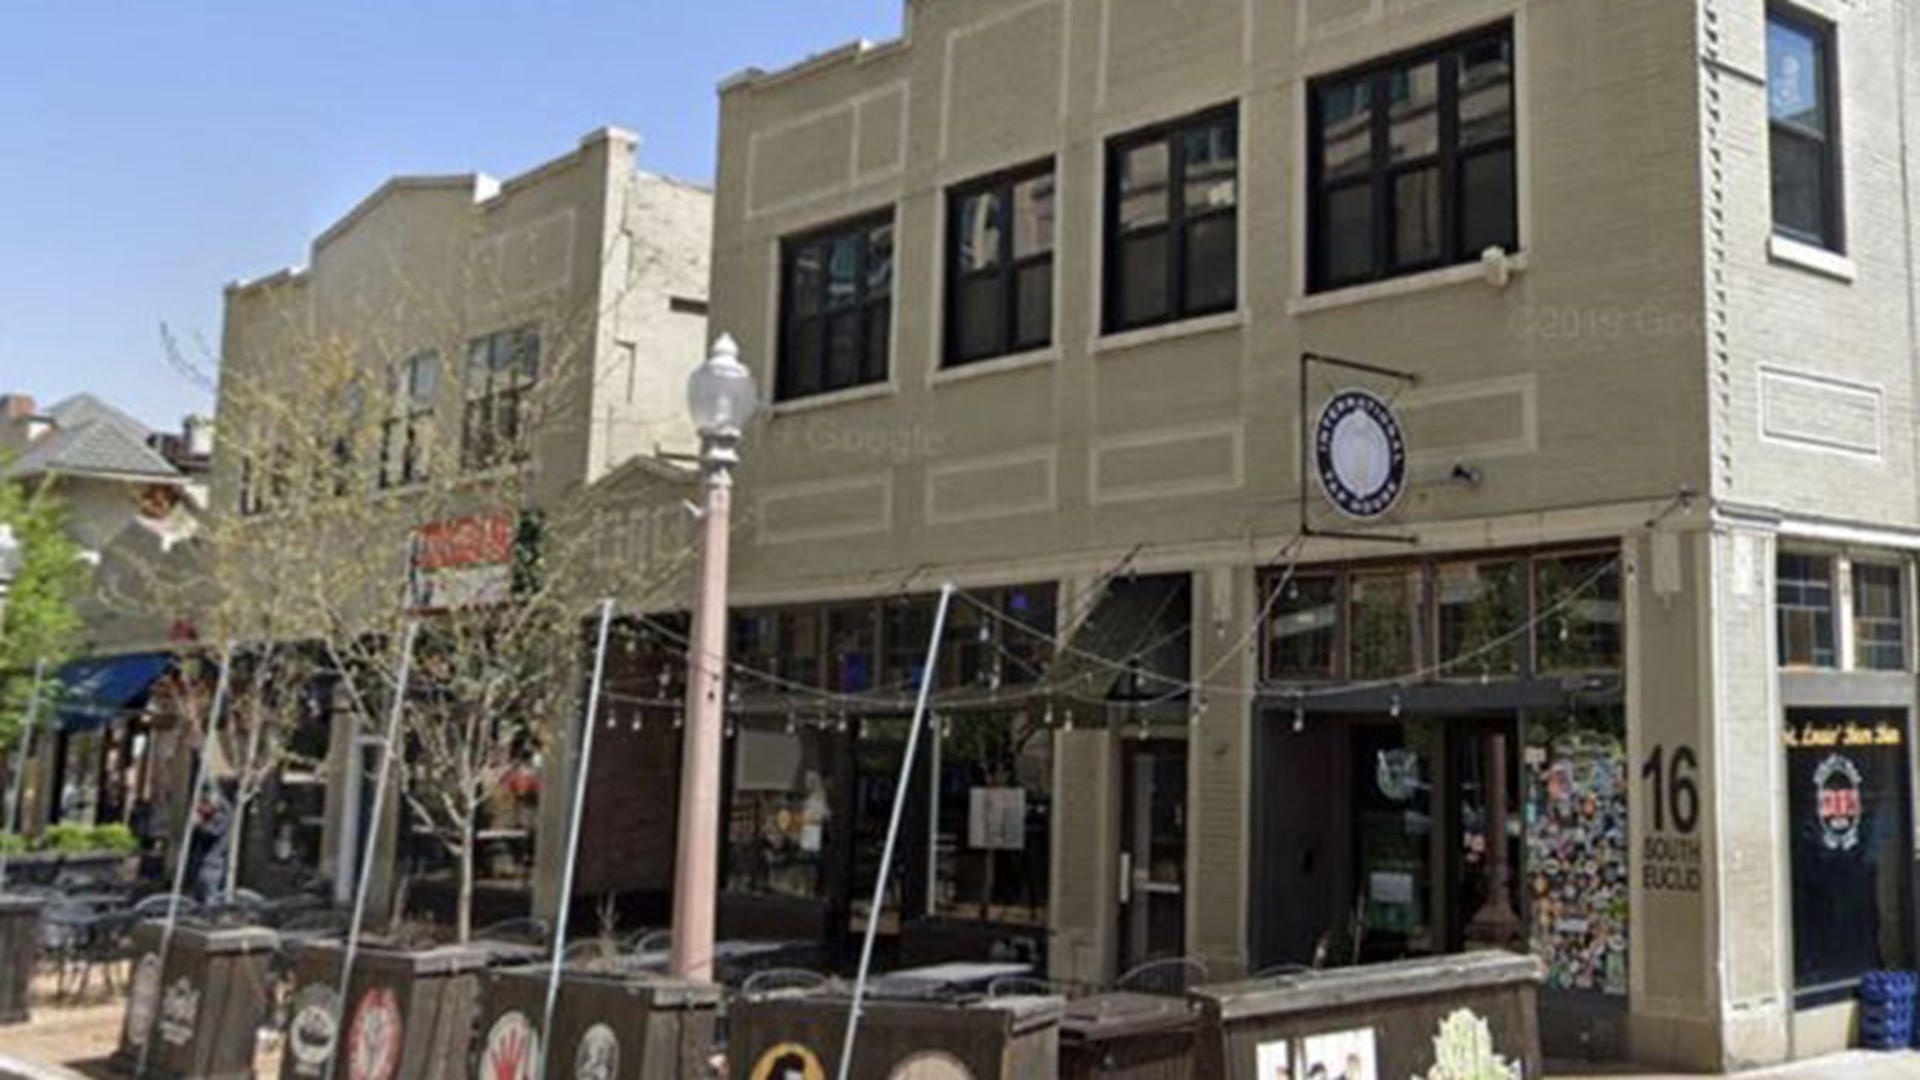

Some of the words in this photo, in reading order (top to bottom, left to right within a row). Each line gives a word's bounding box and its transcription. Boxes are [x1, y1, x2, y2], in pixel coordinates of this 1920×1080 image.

[1319, 397, 1402, 466] INTERNATIONAL
[1324, 470, 1348, 502] TAP
[1349, 481, 1397, 513] HOUSE
[1642, 744, 1699, 835] 16
[1643, 837, 1702, 862] SOUTH
[1642, 863, 1702, 892] EUCLID
